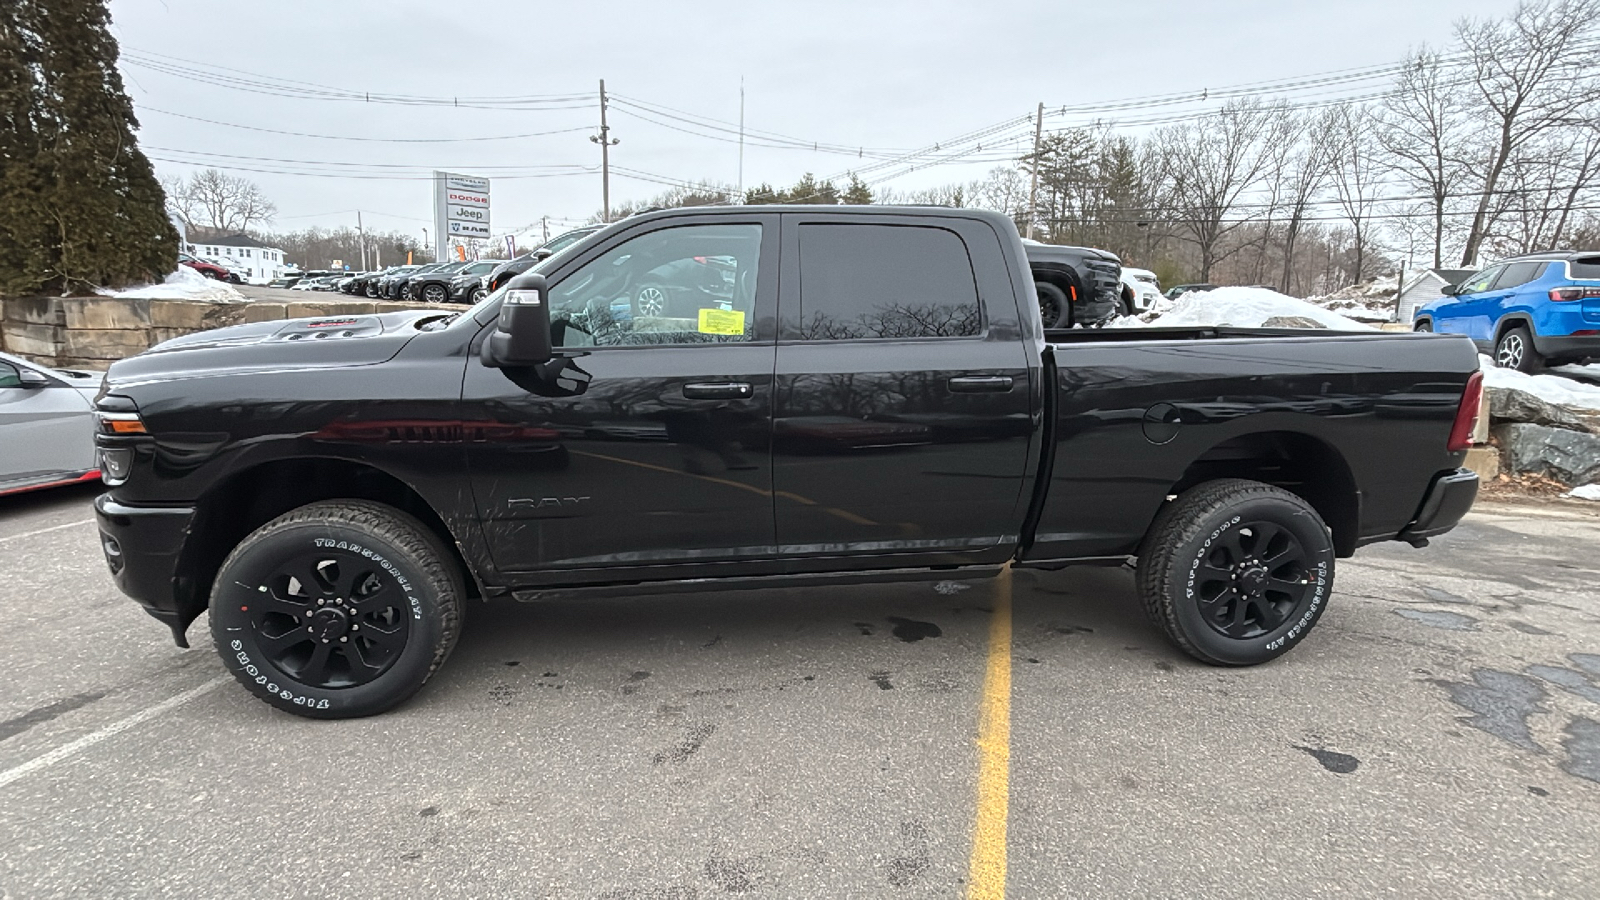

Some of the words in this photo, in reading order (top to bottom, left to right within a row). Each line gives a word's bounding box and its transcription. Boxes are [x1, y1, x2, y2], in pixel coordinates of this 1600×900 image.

[450, 194, 487, 203] DODGE
[456, 207, 483, 220] Jeep
[314, 538, 413, 593] TRANSFORCE
